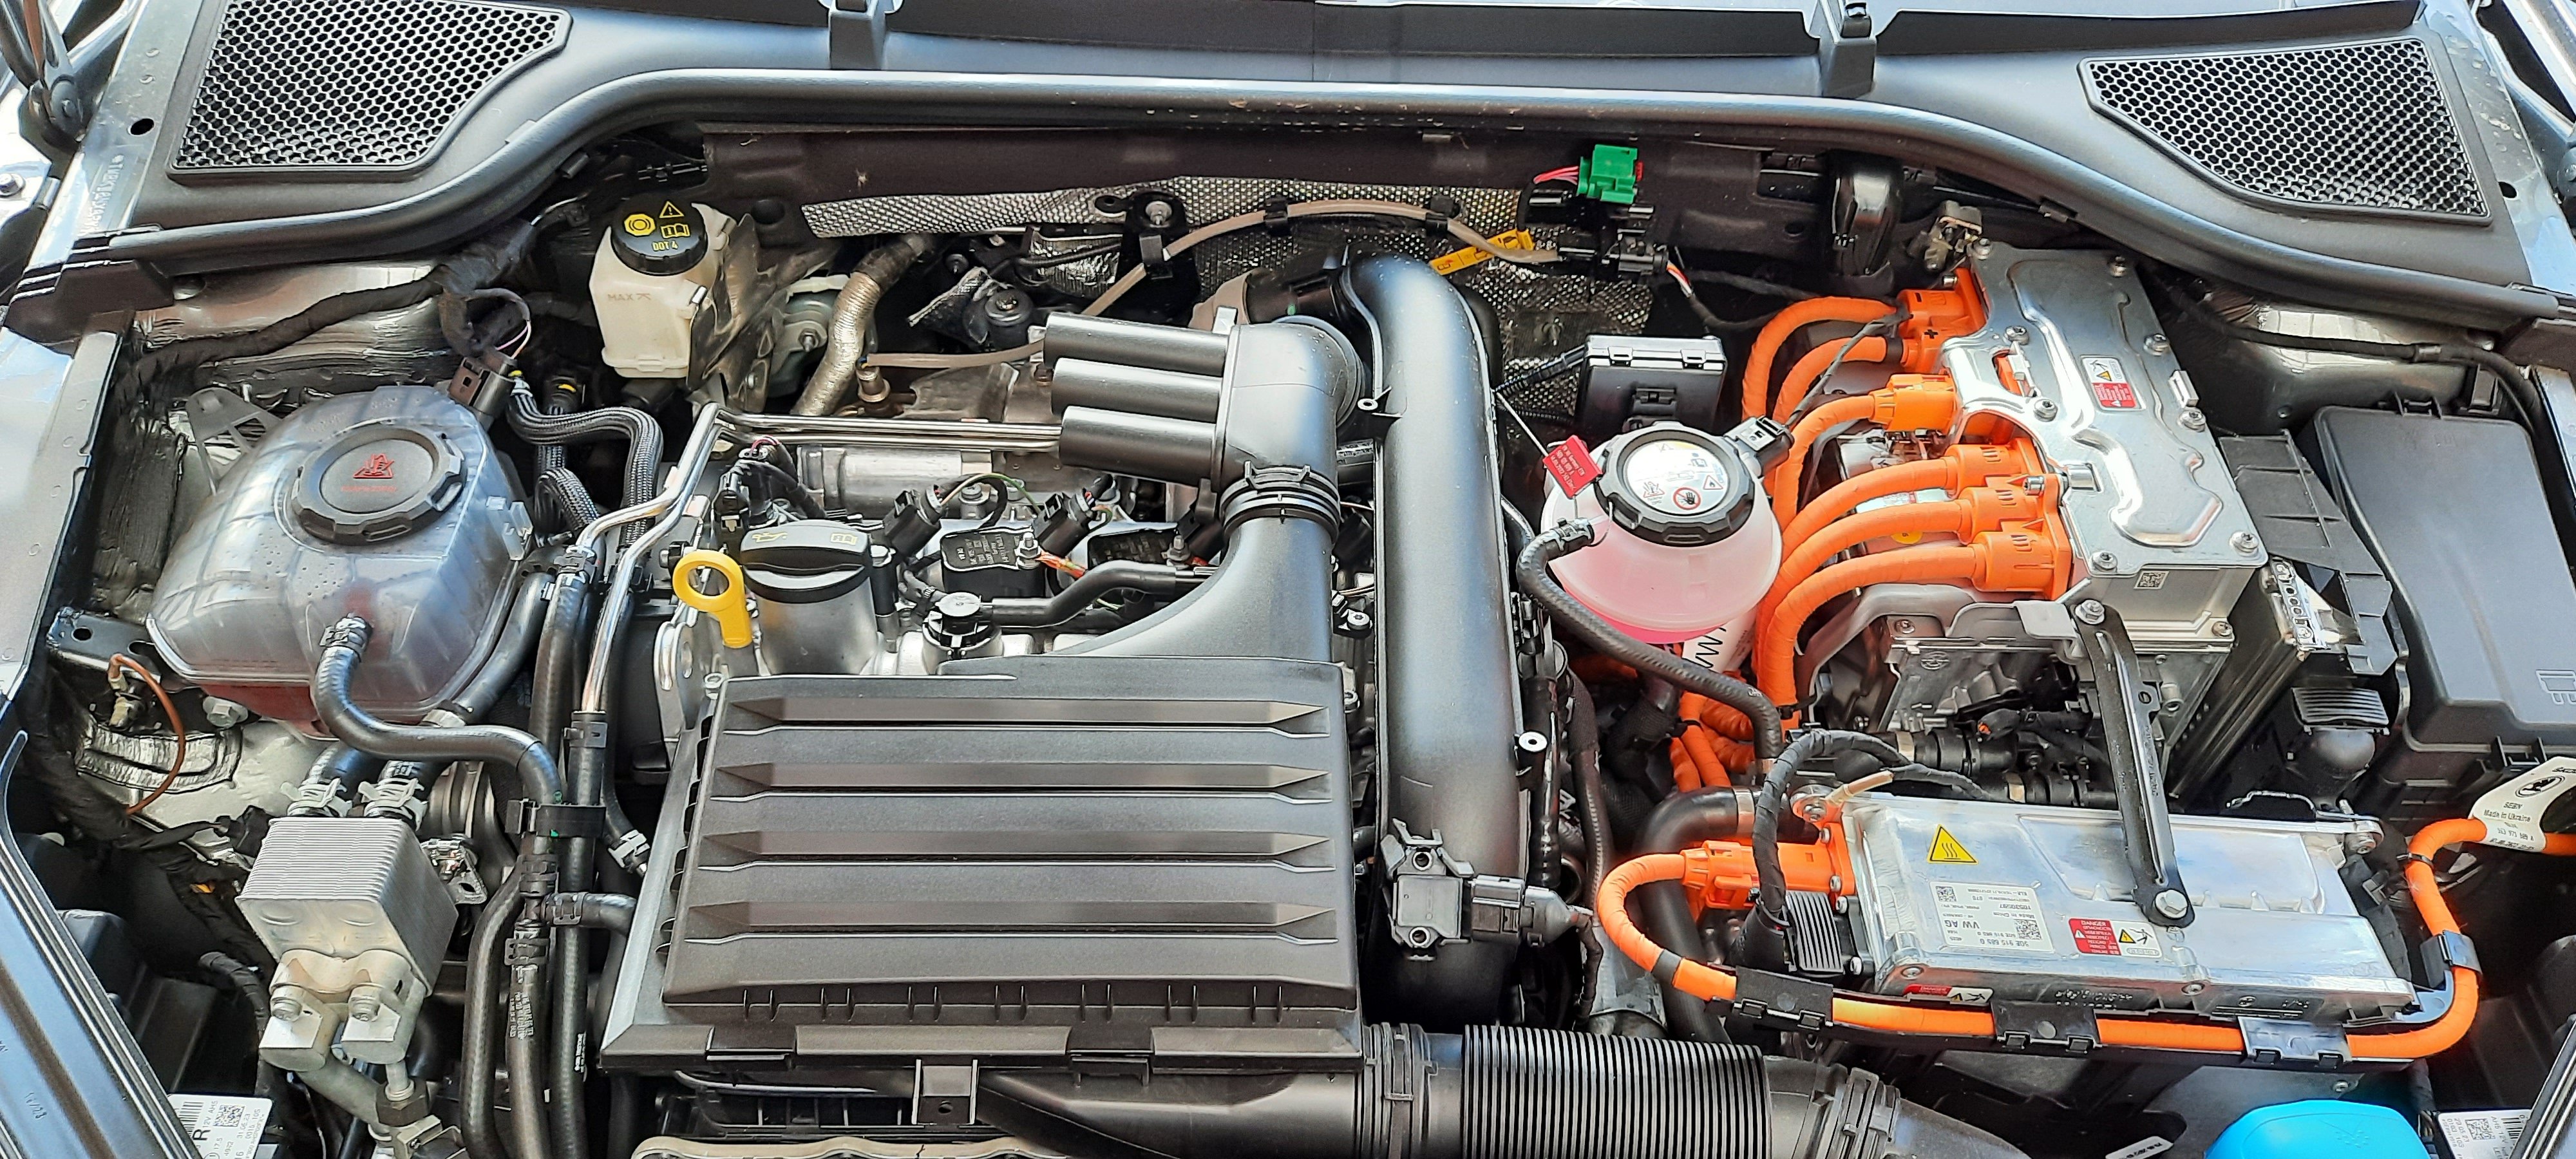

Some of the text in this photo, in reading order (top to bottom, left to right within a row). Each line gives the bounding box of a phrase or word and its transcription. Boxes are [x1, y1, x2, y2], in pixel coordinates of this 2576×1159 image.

[652, 240, 678, 251] DOT 4
[2508, 813, 2531, 822] Ukraine
[1944, 919, 1980, 929] VW AG
[202, 1117, 211, 1128] 12V
[192, 1129, 211, 1141] R
